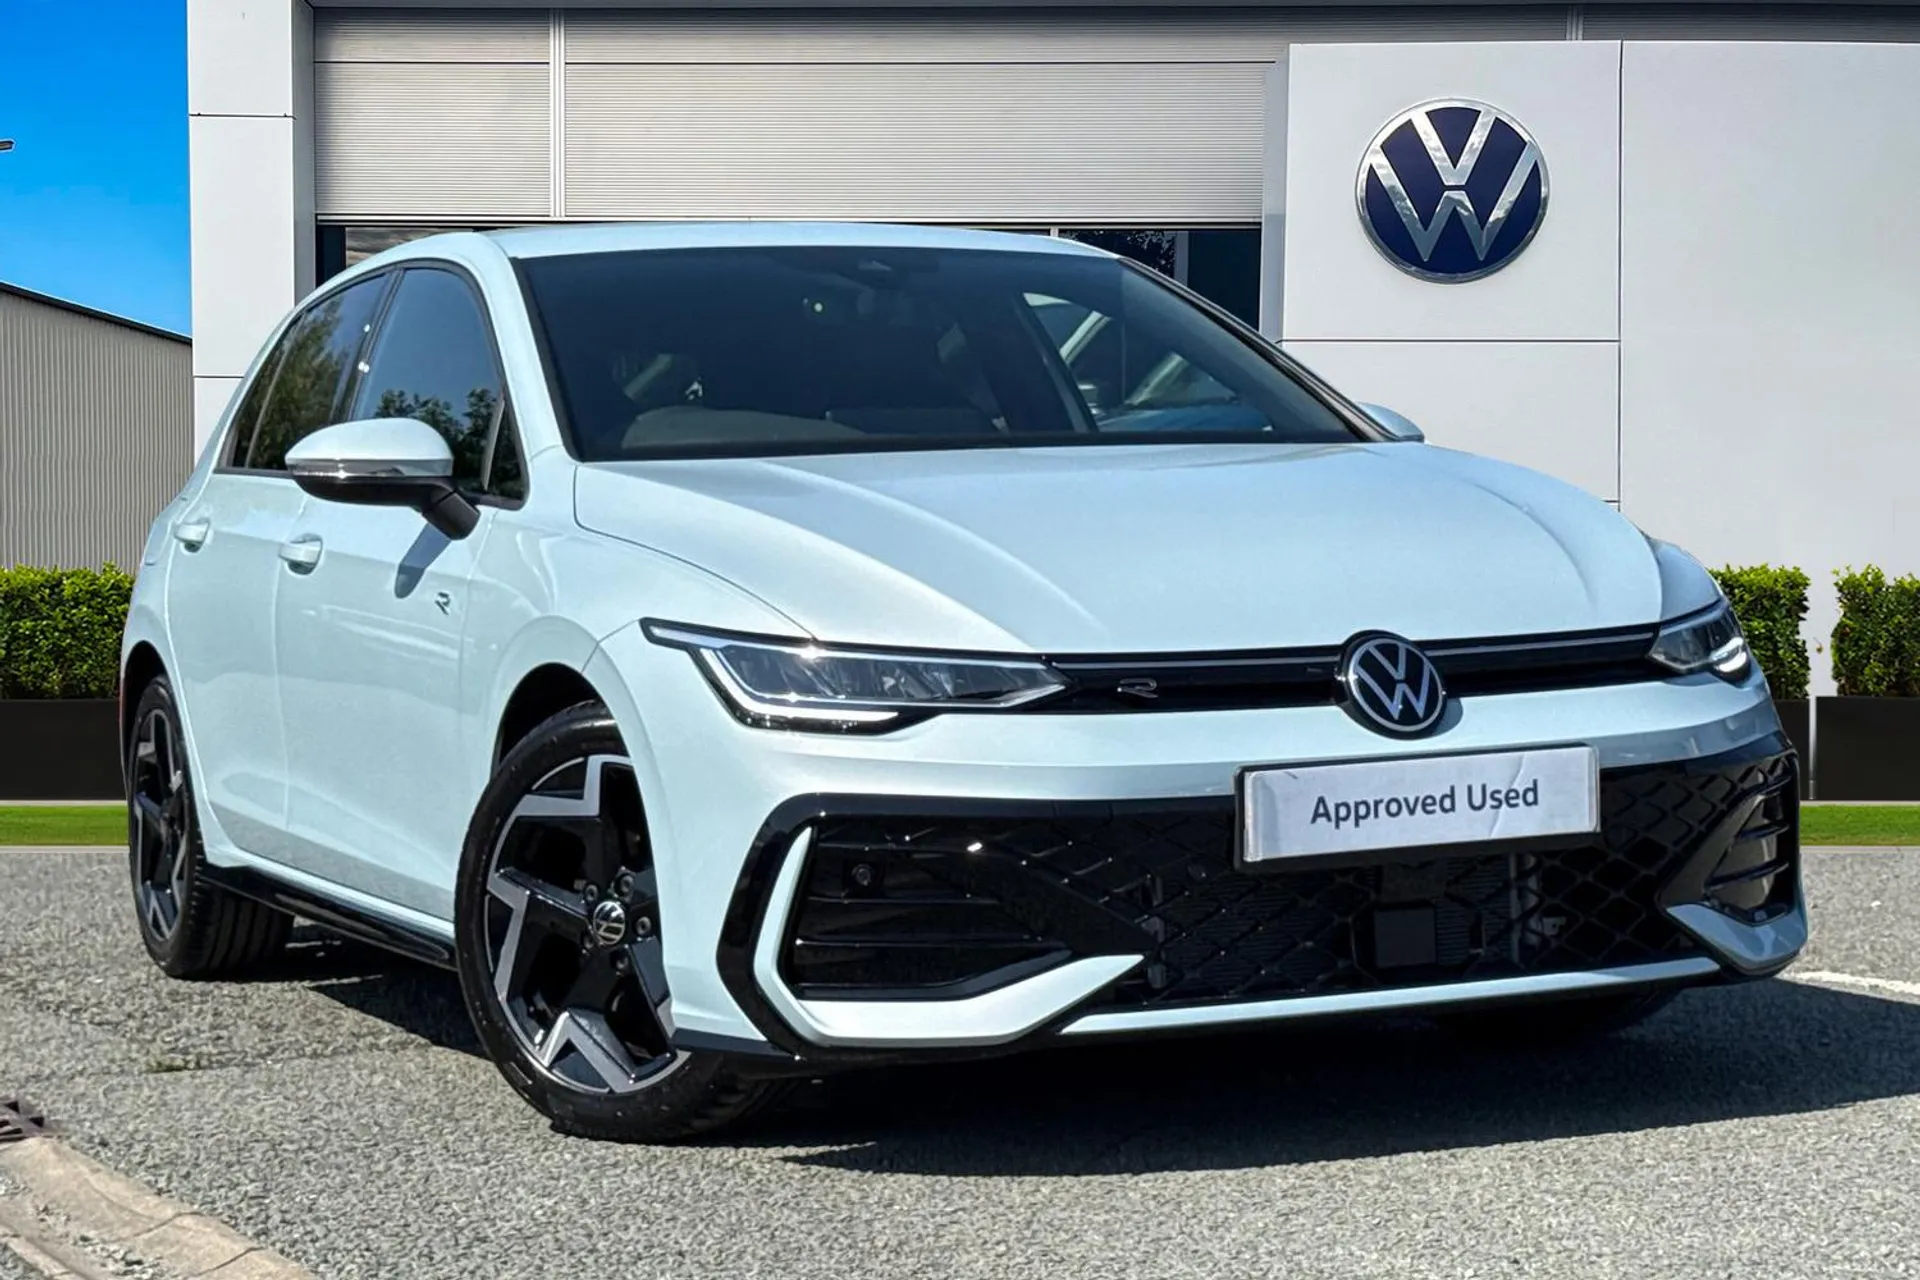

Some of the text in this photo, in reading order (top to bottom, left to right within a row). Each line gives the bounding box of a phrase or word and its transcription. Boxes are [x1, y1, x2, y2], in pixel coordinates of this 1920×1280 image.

[1365, 106, 1542, 264] VW
[1351, 639, 1437, 723] VW
[1310, 778, 1540, 830] Approved Used
